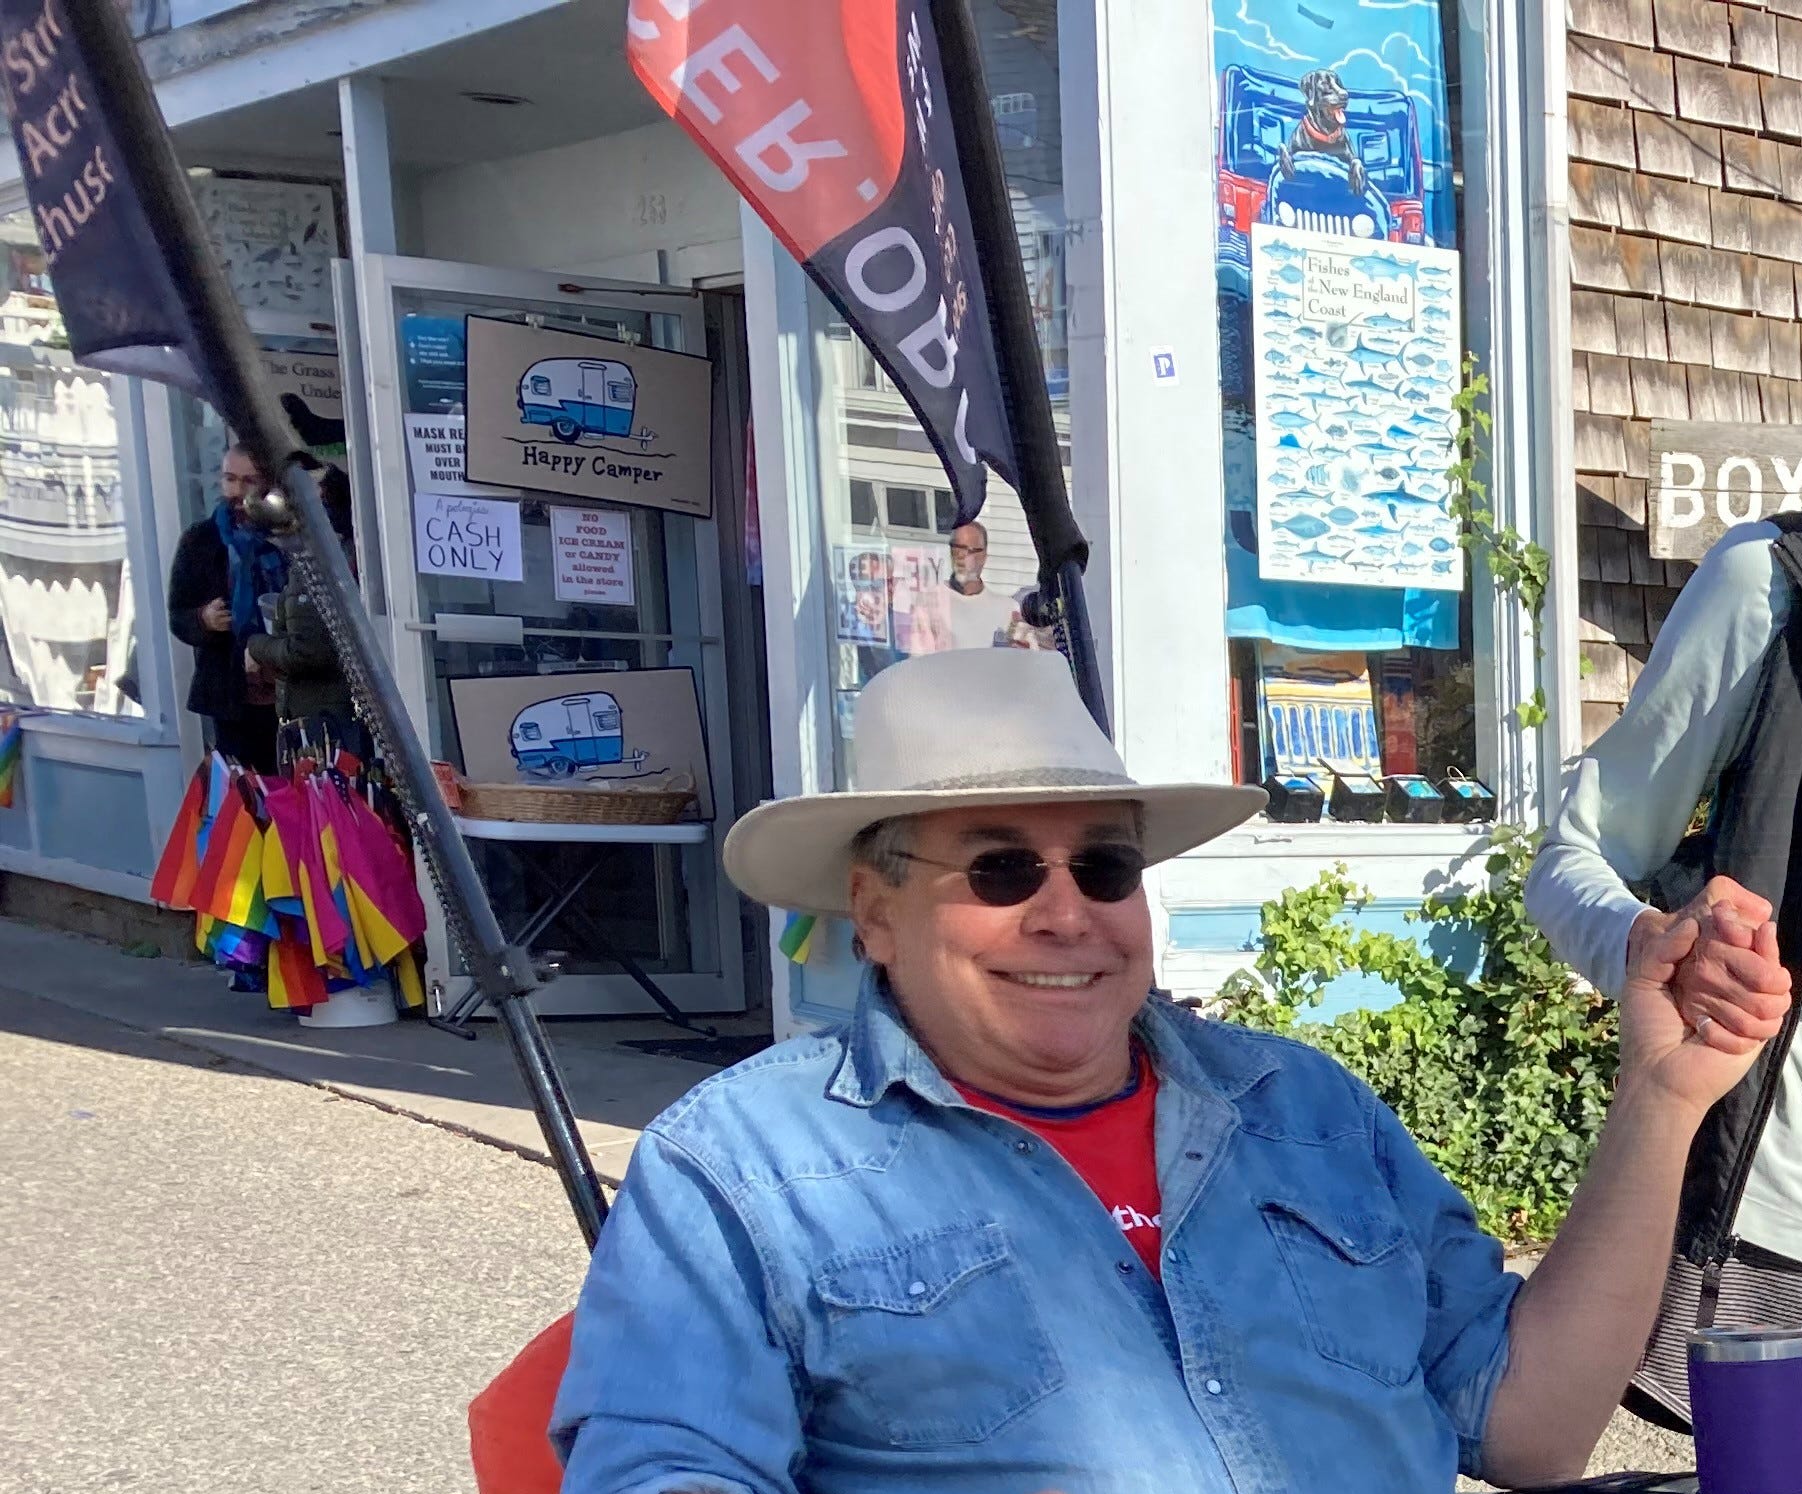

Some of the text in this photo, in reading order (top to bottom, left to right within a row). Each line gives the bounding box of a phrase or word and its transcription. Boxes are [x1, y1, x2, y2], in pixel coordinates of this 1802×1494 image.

[1308, 257, 1350, 276] Fishes
[1319, 279, 1349, 297] New
[1353, 284, 1408, 305] England
[1308, 299, 1346, 317] Coast
[292, 362, 335, 378] Grass
[300, 383, 341, 399] Unde
[414, 427, 465, 440] MASK RE
[425, 443, 451, 454] MUST
[435, 457, 461, 468] OVER
[522, 446, 663, 485] Happy Camper
[430, 470, 465, 481] MOUTH
[581, 513, 599, 522] NO
[426, 517, 501, 548] CASH
[576, 525, 607, 535] FOOD
[559, 537, 625, 549] ICE CREAM
[428, 543, 504, 572] ONLY
[579, 551, 620, 562] CANDY
[572, 563, 614, 574] allowed
[562, 574, 624, 587] in the store
